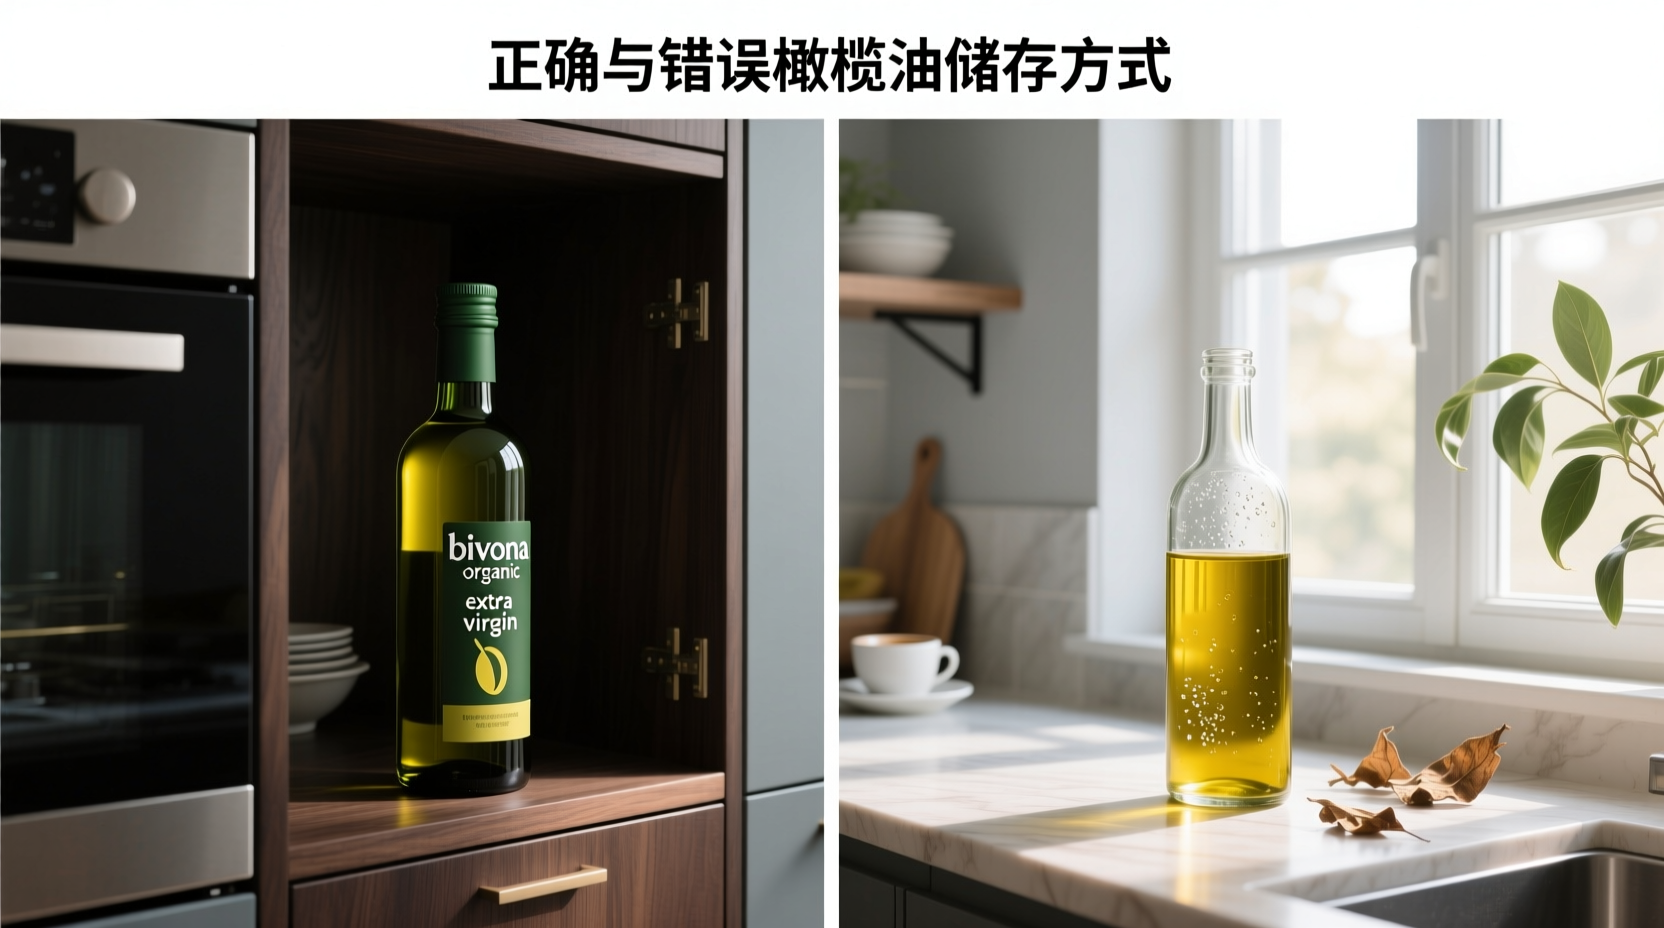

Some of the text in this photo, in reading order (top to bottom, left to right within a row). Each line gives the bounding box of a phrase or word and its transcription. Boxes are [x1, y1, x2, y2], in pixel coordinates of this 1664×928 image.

[448, 532, 530, 562] bivona
[462, 562, 521, 585] organic
[465, 594, 513, 610] extra
[463, 611, 518, 637] virgin
